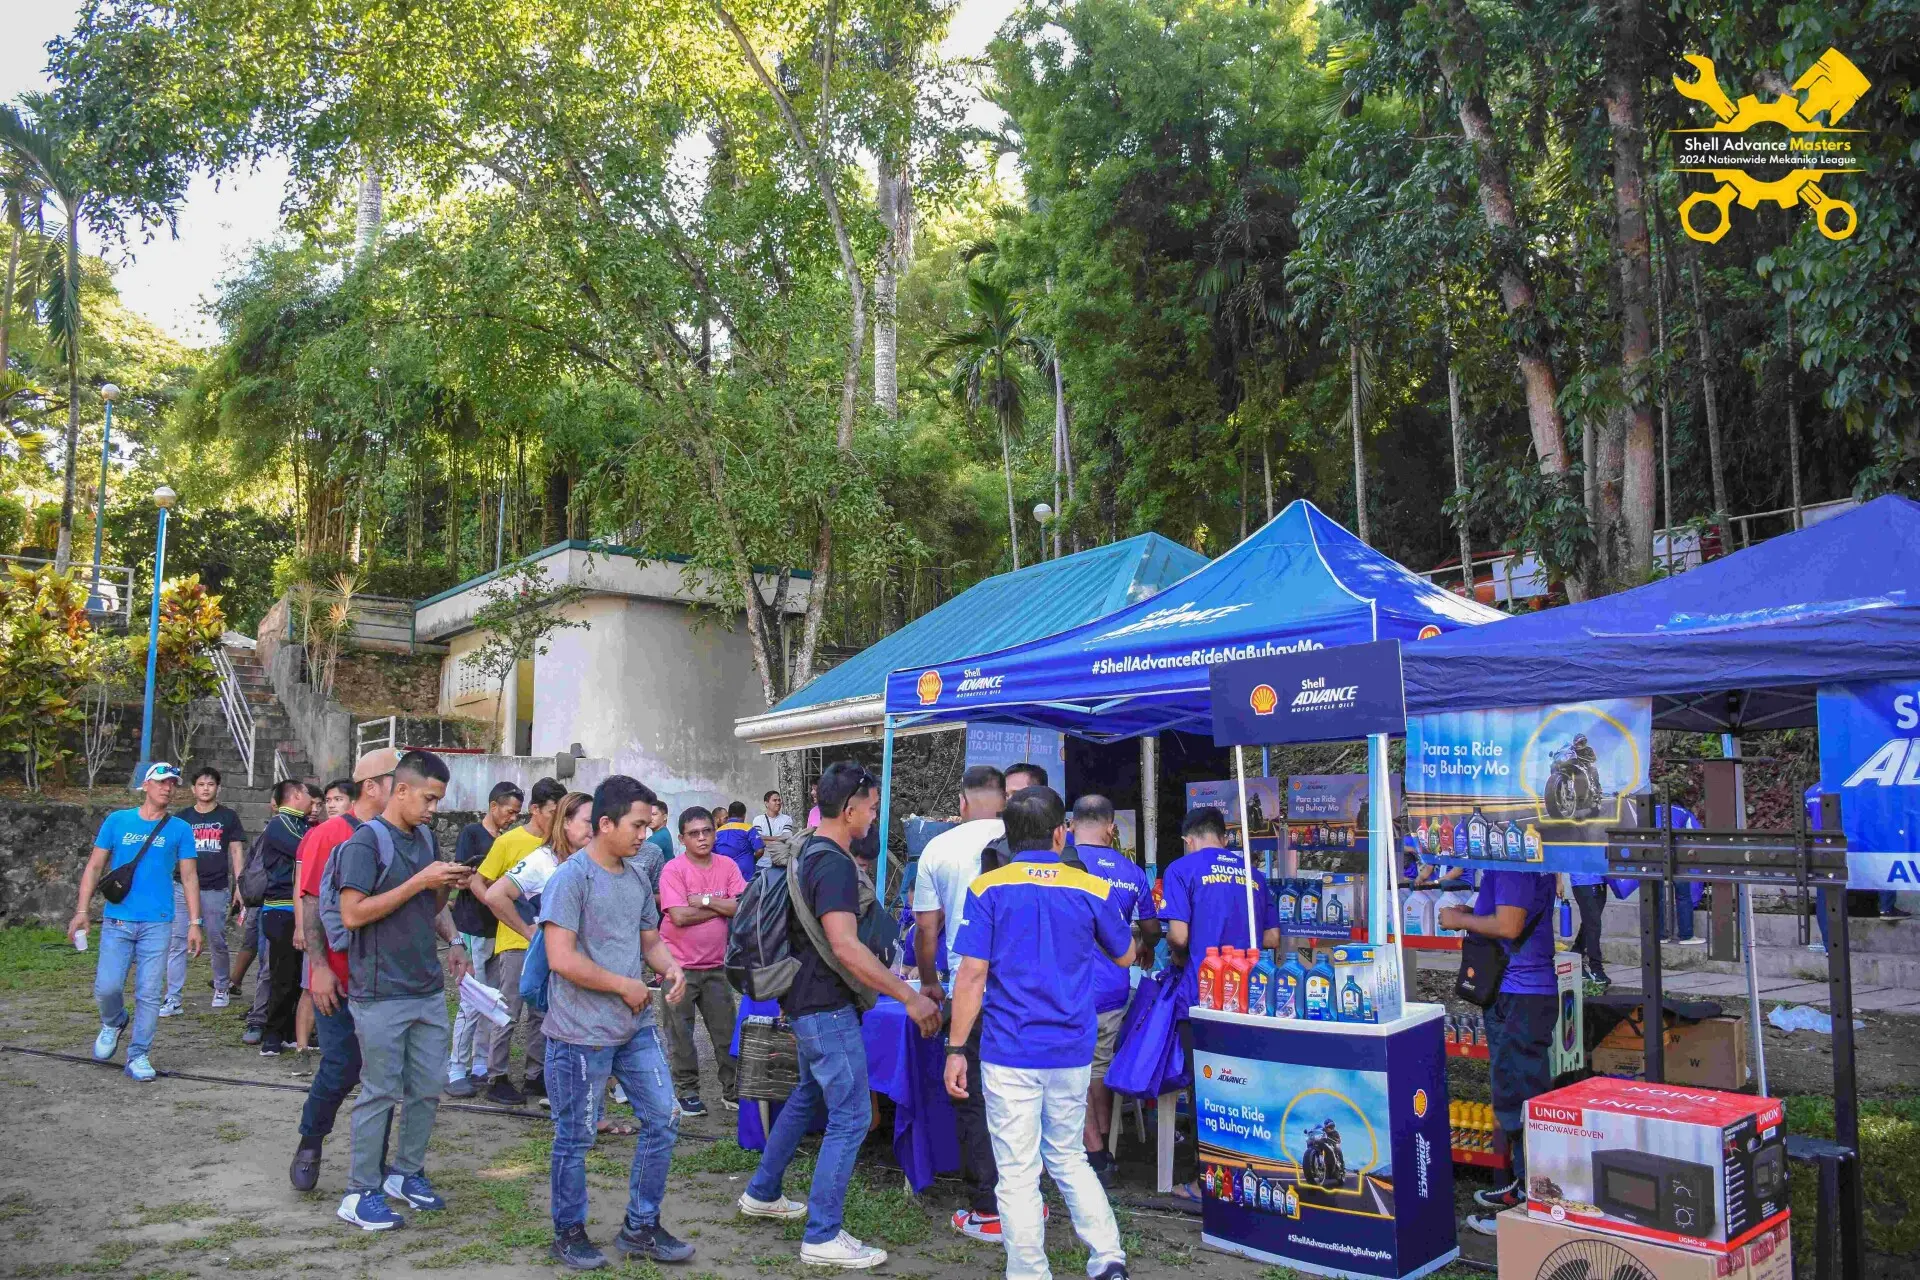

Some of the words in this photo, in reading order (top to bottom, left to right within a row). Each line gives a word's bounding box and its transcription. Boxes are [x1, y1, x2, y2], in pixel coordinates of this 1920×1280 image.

[964, 668, 980, 678] Shell
[957, 675, 1005, 692] ADVANCE
[1302, 677, 1324, 690] Shell
[1291, 686, 1358, 706] ADVANCE
[1291, 704, 1335, 713] MOTORCYCLE
[1894, 691, 1920, 729] S
[1423, 741, 1449, 756] Para
[1454, 745, 1467, 756] sa
[1472, 739, 1503, 756] Ride
[1440, 760, 1482, 779] Buhay
[1484, 762, 1509, 775] Mo
[1305, 804, 1327, 813] Buhay
[1028, 869, 1059, 878] FAST
[1202, 874, 1232, 884] PINOY
[1217, 1074, 1247, 1086] ADVANCE
[1628, 1087, 1717, 1102] UNION
[1204, 1098, 1225, 1115] Para
[1228, 1106, 1239, 1117] sa
[1242, 1105, 1264, 1122] Ride
[1534, 1107, 1576, 1122] UNION
[1588, 1099, 1679, 1114] UNION
[1760, 1108, 1777, 1124] UNION
[1205, 1119, 1217, 1132] ng
[1219, 1119, 1250, 1139] Buhay
[1253, 1125, 1271, 1140] Mo
[1528, 1122, 1578, 1137] MICROWAVE
[1580, 1130, 1604, 1140] OVEN
[1418, 1132, 1428, 1198] ADVANCE
[1288, 1234, 1391, 1260] #ShellAdvanceRideNgBuhayMo
